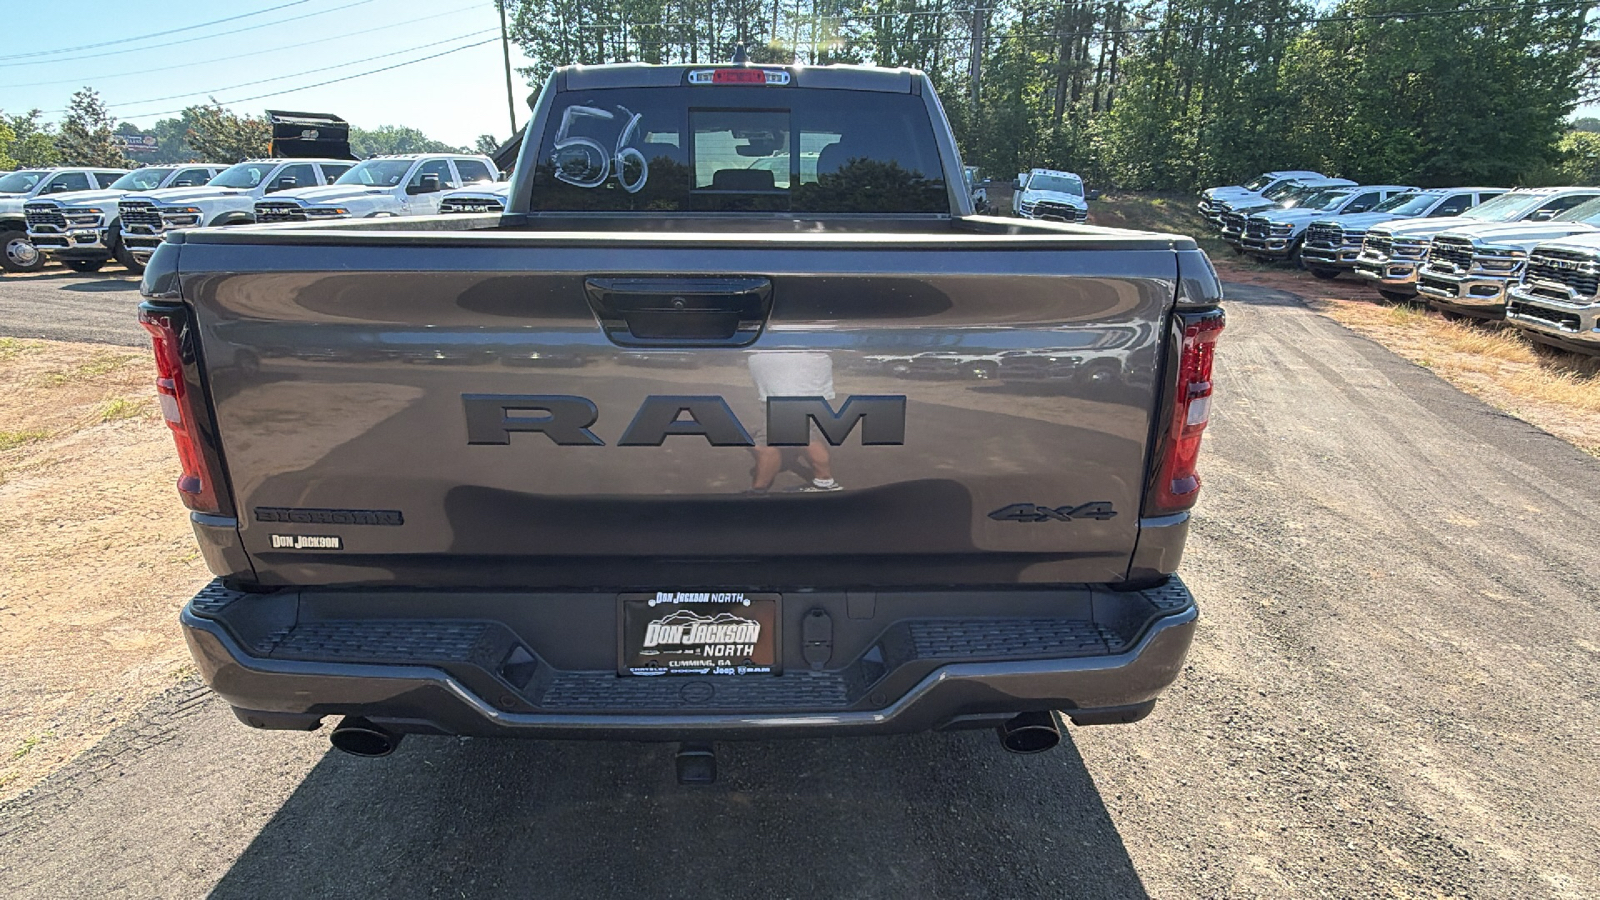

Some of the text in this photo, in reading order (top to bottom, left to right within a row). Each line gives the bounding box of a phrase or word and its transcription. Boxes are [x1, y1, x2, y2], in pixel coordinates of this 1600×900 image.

[461, 393, 907, 448] RAM
[711, 592, 744, 604] NORTH
[703, 644, 754, 657] NORTH
